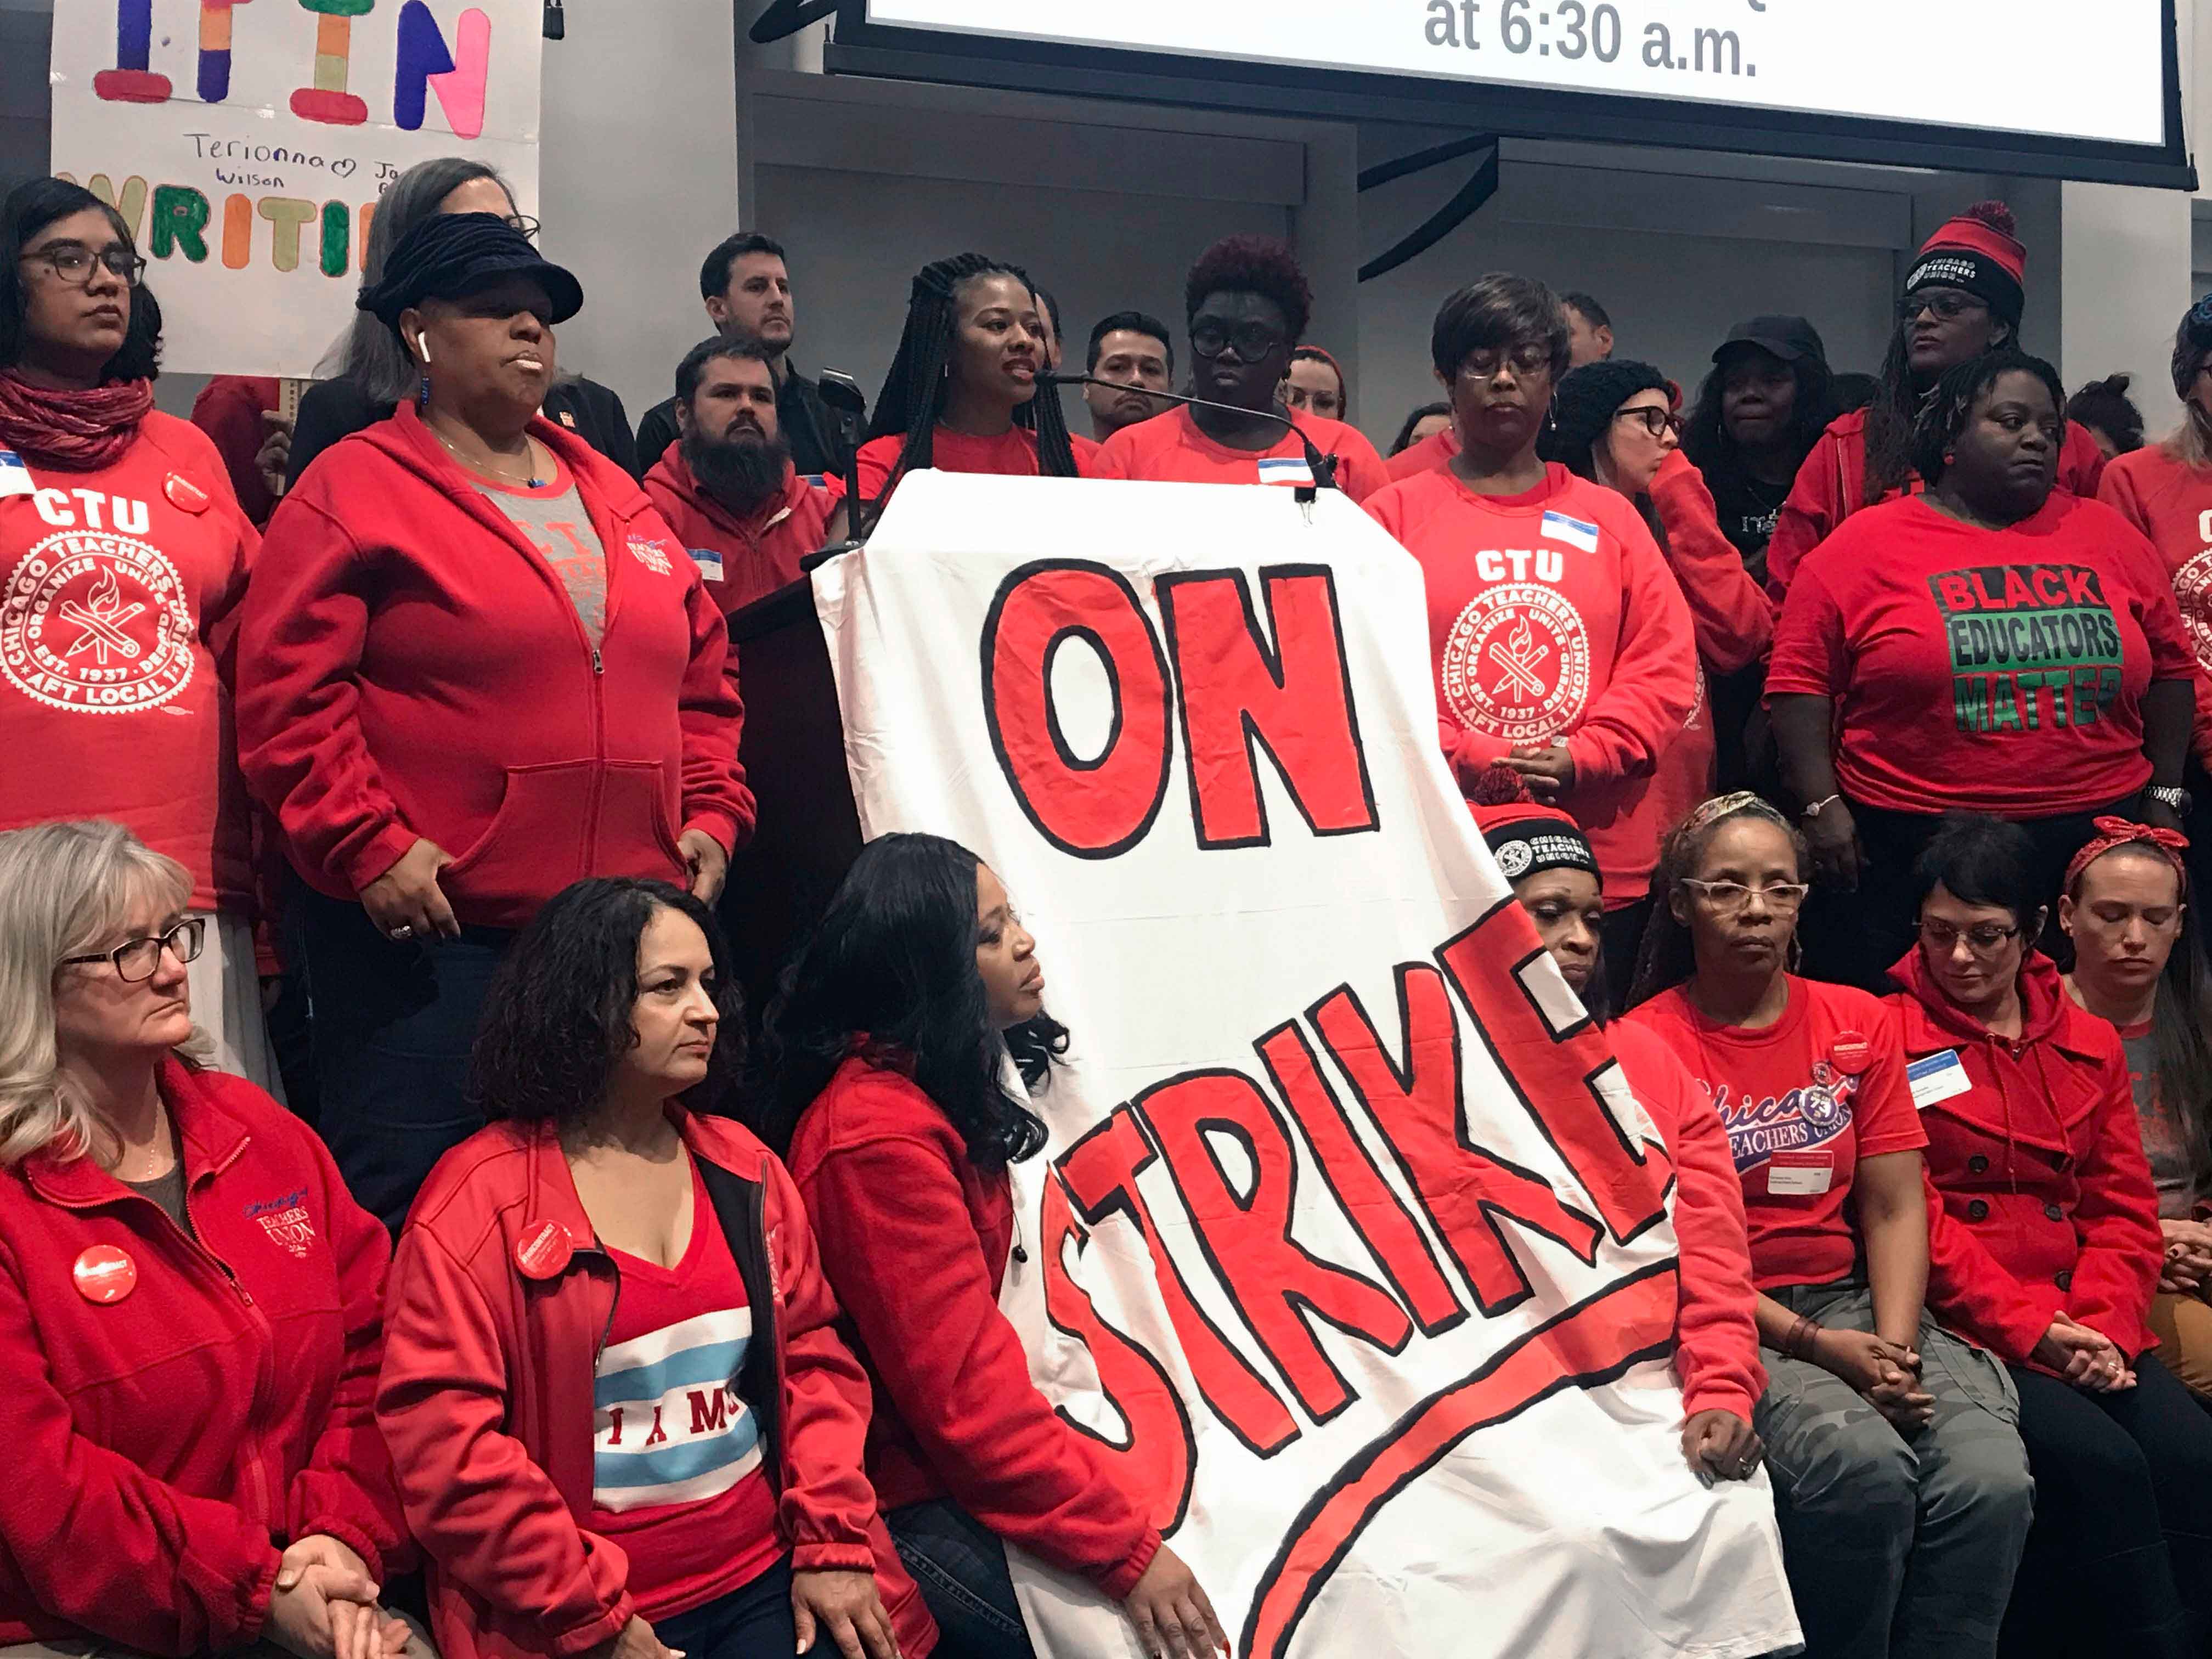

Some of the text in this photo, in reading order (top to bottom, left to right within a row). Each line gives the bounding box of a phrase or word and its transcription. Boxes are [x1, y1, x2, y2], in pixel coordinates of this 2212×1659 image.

[1425, 0, 1757, 77] at 6:30 a.m.
[289, 0, 491, 140] IN
[182, 133, 325, 168] Terionna
[55, 171, 377, 278] RITI
[1926, 264, 1976, 279] TEACHERS
[33, 487, 150, 535] CTU
[1474, 549, 1564, 583] CTU
[1937, 567, 2105, 613] BLACK
[3, 558, 48, 666] CHICAGO
[49, 537, 174, 593] TEACHERS
[27, 557, 166, 640] ORGANIZE UNITE
[1448, 590, 1585, 701] CHICAGO TEACHERS UNION
[1466, 608, 1566, 677] ORGANIZE UNITE
[1950, 612, 2120, 666] EDUCATORS
[26, 673, 79, 701] AFT
[86, 679, 167, 705] LOCAL
[79, 667, 128, 682] 1937
[1500, 707, 1535, 720] 1937
[1542, 652, 1570, 711] DEFEND
[981, 558, 1380, 860] ON
[1463, 707, 1499, 734] AFT
[1502, 715, 1561, 738] LOCAL
[1729, 1122, 1808, 1159] EACHERS
[1040, 895, 1679, 1542] STRIKE
